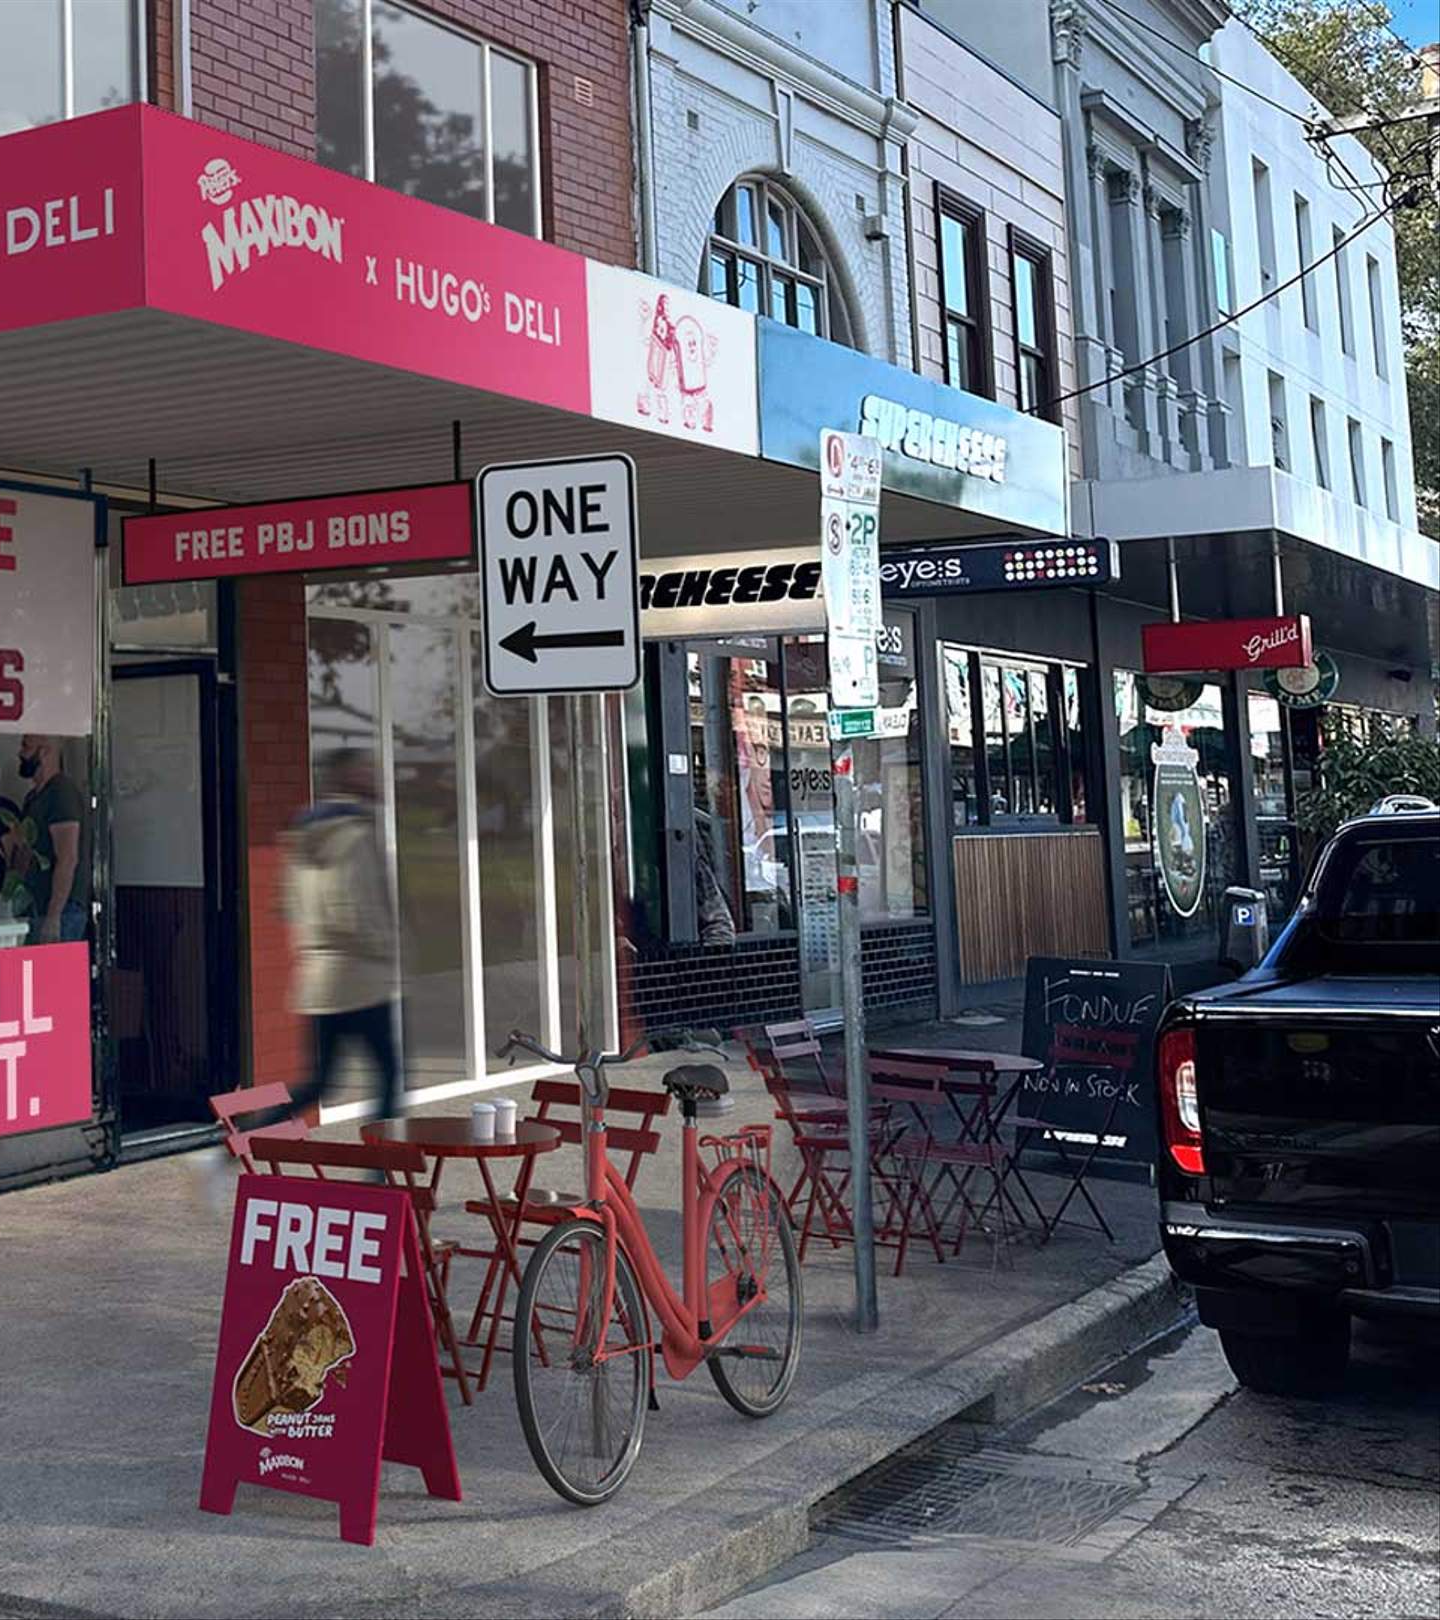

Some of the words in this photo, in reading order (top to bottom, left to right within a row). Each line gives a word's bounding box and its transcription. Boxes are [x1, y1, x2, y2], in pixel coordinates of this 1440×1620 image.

[7, 188, 114, 256] DELI
[201, 195, 343, 291] MAXIBON
[505, 293, 560, 347] DELI
[175, 527, 244, 562] FREE
[258, 520, 314, 555] PBJ
[328, 510, 410, 549] BONS
[506, 484, 610, 539] ONE
[851, 513, 876, 546] 2P
[498, 550, 618, 605] WAY
[1241, 622, 1300, 662] Grill'd
[1238, 907, 1250, 924] P
[1043, 976, 1156, 1025] FONDUE
[1064, 1078, 1079, 1097] IN
[1086, 1073, 1141, 1106] STOK
[240, 1198, 387, 1284] FREE
[267, 1412, 312, 1425] PEANUT
[287, 1425, 333, 1438] BUTTER
